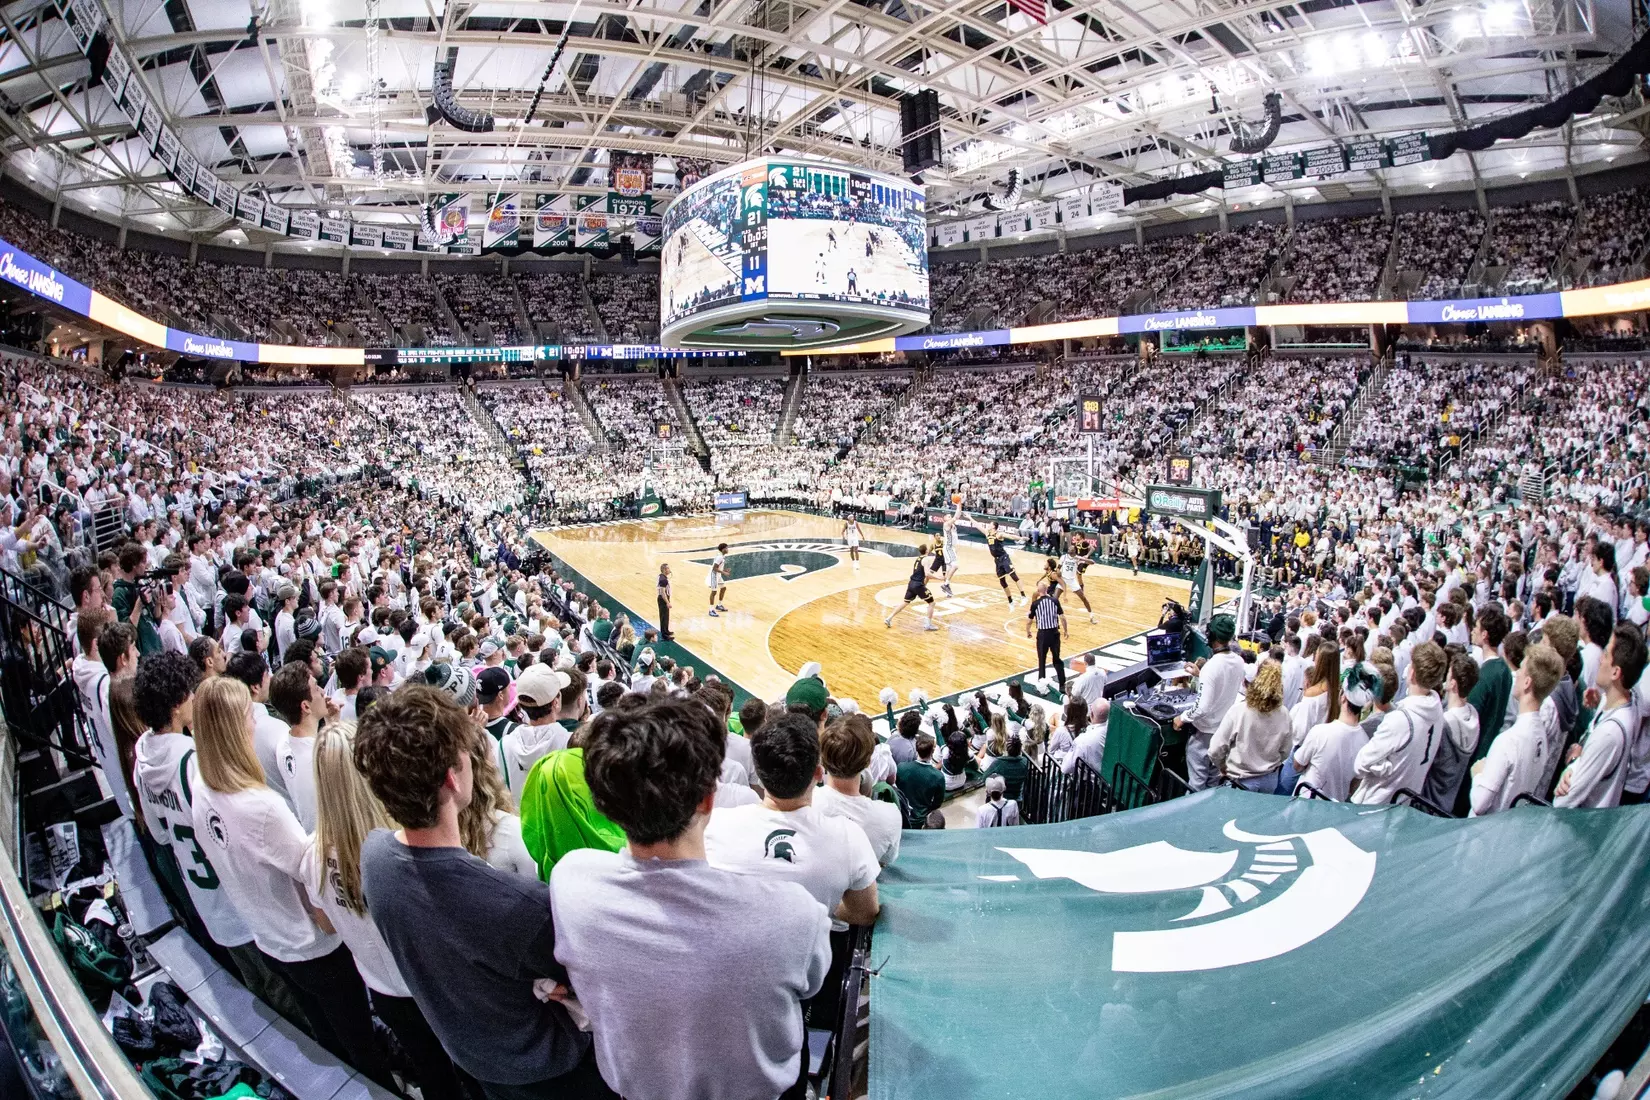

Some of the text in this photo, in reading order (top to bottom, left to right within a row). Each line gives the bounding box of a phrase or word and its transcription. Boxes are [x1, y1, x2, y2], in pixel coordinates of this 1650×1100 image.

[1394, 135, 1422, 143] WOMEN'S
[1352, 141, 1380, 150] WOMEN'S
[1393, 144, 1429, 156] CHAMPIONS
[1266, 154, 1294, 162] WOMEN'S
[1308, 157, 1343, 166] CHAMPIONS
[1350, 152, 1388, 162] CHAMPIONS
[1226, 161, 1253, 169] WOMEN'S
[1265, 164, 1300, 174] CHAMPIONS
[1316, 165, 1336, 173] 2005
[793, 167, 804, 177] 21
[1224, 171, 1259, 180] CHAMPIONS
[851, 180, 870, 190] 10:03
[906, 190, 911, 199] 11
[1093, 193, 1119, 202] HEATHCOTE
[612, 205, 646, 215] 1979
[748, 211, 760, 225] 21
[744, 232, 767, 243] 10:03
[750, 256, 759, 270] 11
[0, 253, 64, 302] Choose LANSING
[745, 275, 764, 295] M
[1442, 298, 1524, 321] Choose LANSING
[1144, 311, 1216, 330] Choose LANSING
[924, 334, 984, 349] Choose LANSING
[184, 337, 234, 357] Choose LANSING
[591, 347, 597, 355] 11
[549, 348, 558, 357] 21
[1172, 460, 1189, 468] 10:03
[1171, 468, 1189, 480] 21
[1151, 491, 1188, 512] O'Reilly
[1187, 504, 1206, 512] PARTS
[341, 636, 349, 649] 12
